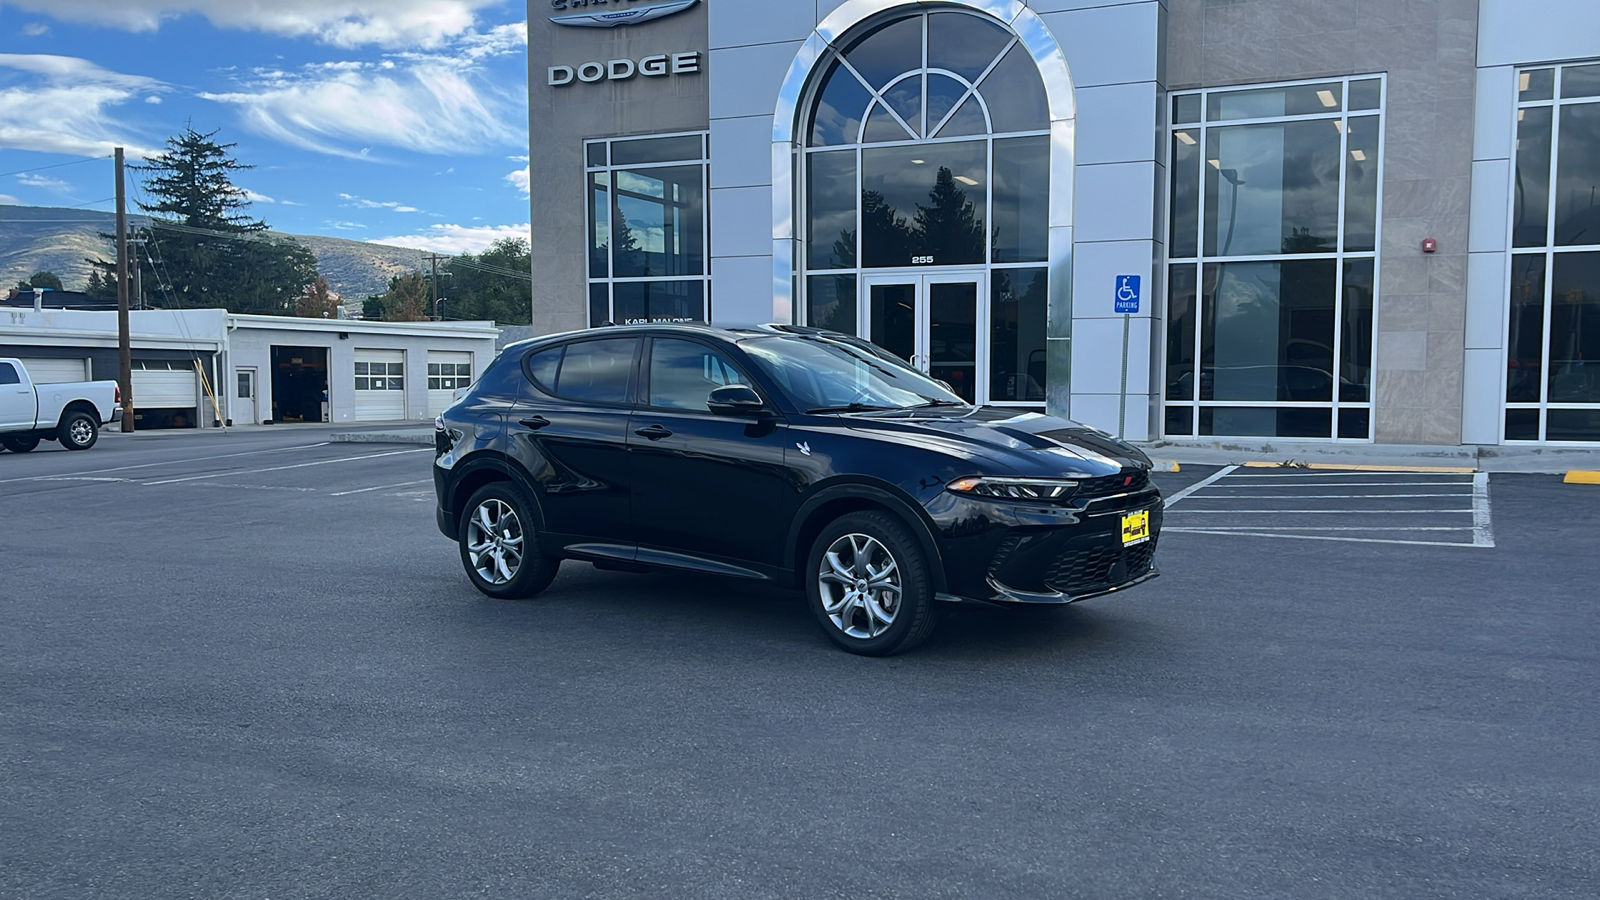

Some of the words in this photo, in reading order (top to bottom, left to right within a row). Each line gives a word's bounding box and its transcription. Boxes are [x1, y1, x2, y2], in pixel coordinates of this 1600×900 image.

[548, 51, 700, 86] DODGE
[911, 255, 934, 264] 255
[1116, 301, 1138, 309] PARKING
